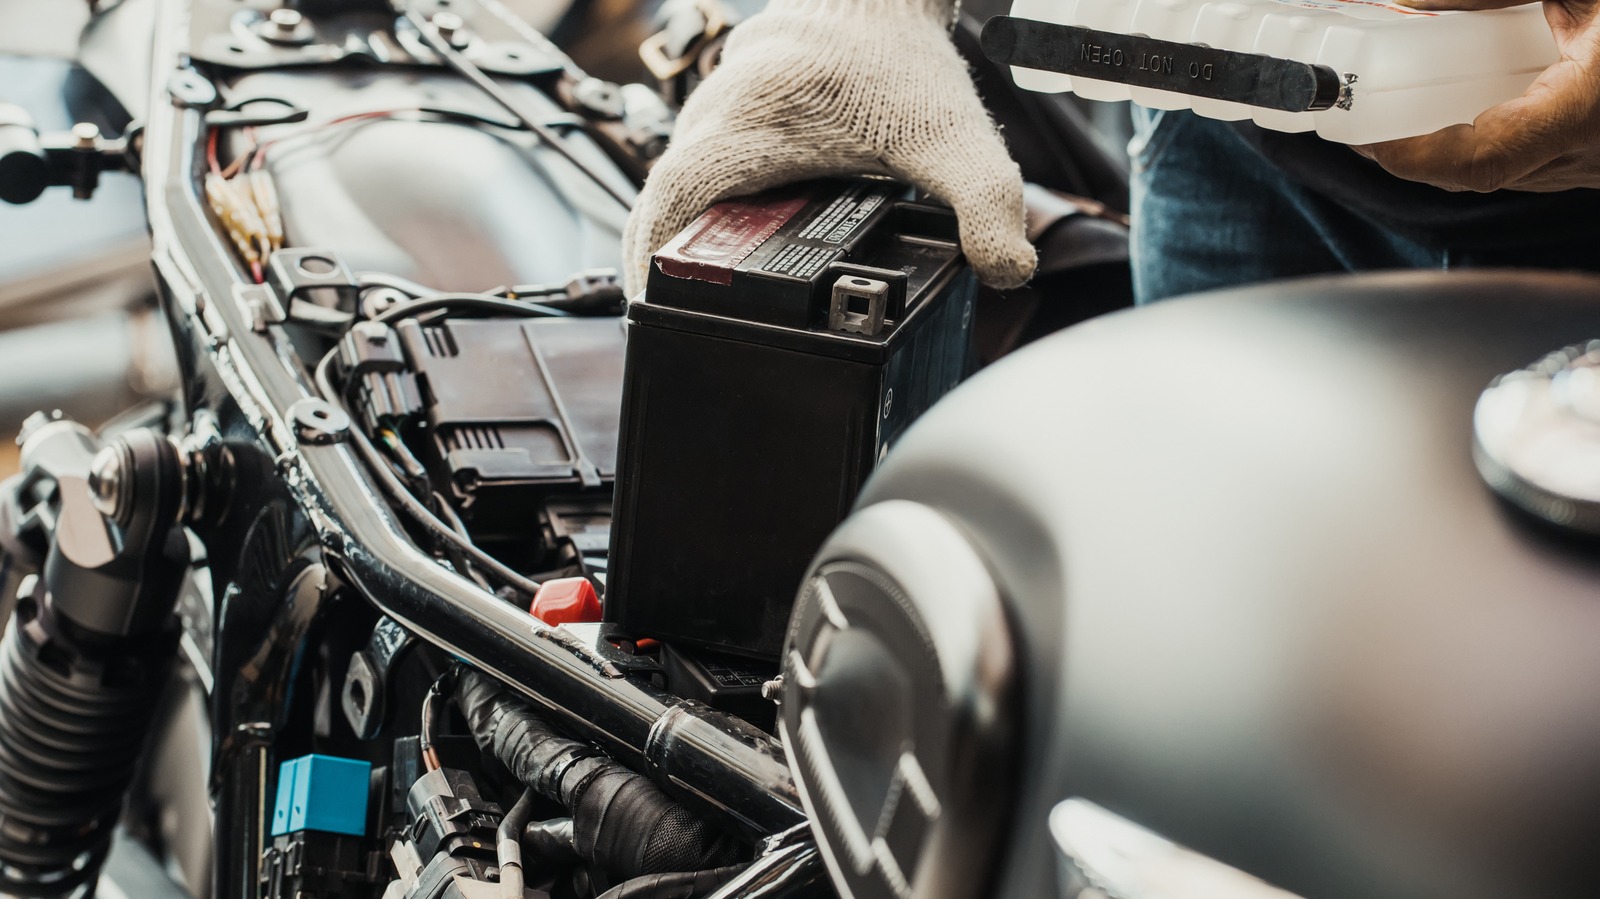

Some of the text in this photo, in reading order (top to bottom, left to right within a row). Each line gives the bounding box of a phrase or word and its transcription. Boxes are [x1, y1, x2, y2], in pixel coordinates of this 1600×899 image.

[1080, 43, 1213, 81] DO NOT OPEN
